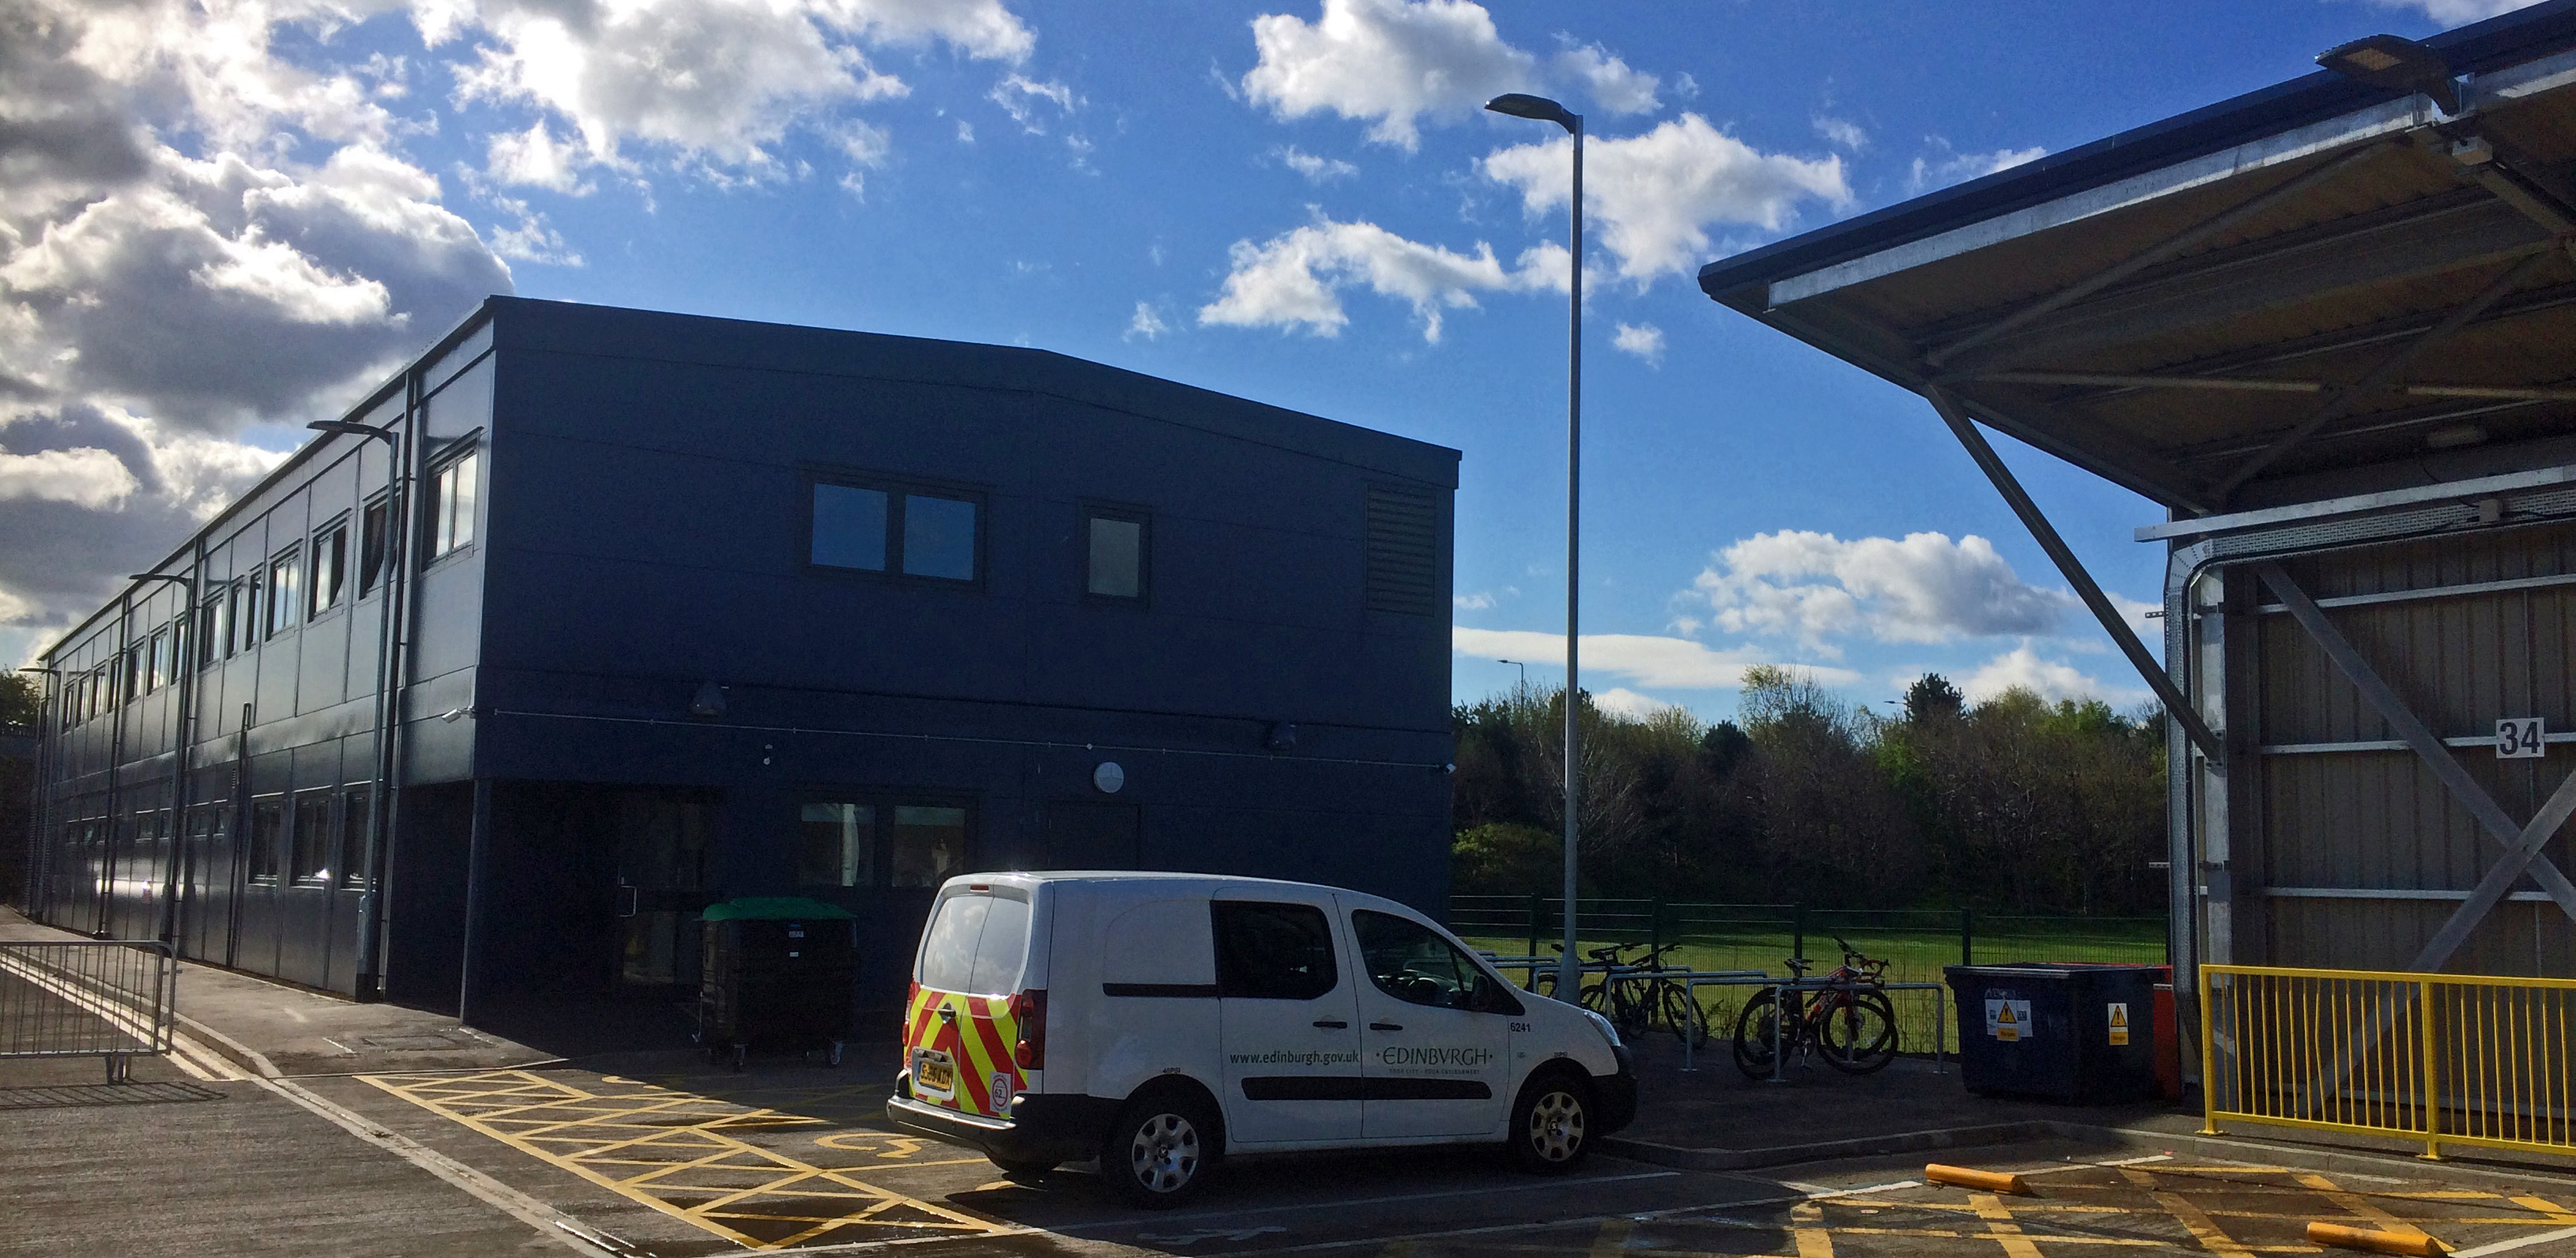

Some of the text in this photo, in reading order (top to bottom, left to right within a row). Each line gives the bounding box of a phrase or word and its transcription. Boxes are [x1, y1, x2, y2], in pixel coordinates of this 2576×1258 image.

[2499, 721, 2540, 755] 34
[1510, 1023, 1531, 1032] 6241
[1230, 1050, 1359, 1065] www.edinburgh.gov.uk
